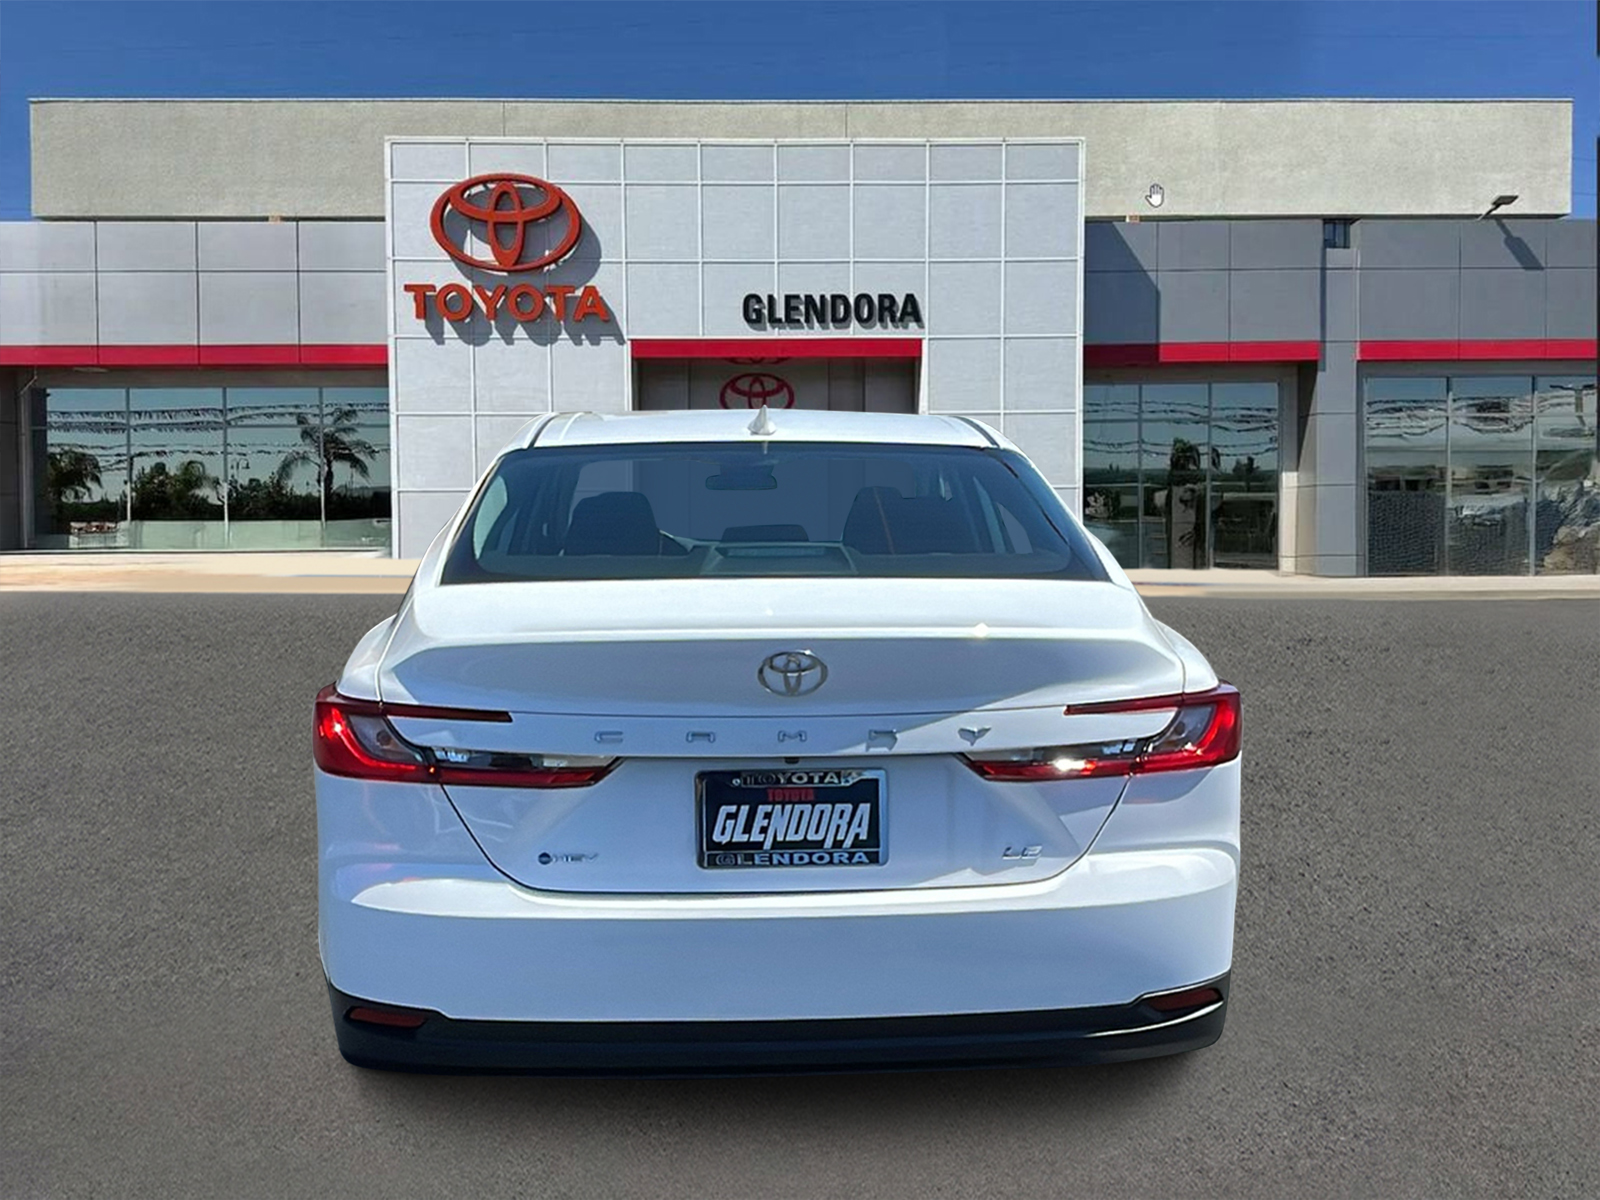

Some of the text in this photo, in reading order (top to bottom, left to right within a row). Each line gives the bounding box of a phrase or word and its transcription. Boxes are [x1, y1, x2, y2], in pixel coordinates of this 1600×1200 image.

[404, 283, 610, 323] TOYOTA
[742, 293, 922, 325] GLENDORA
[743, 771, 840, 785] TOYOTA
[712, 802, 871, 850] GLENDORA
[716, 851, 870, 866] GLENDORA
